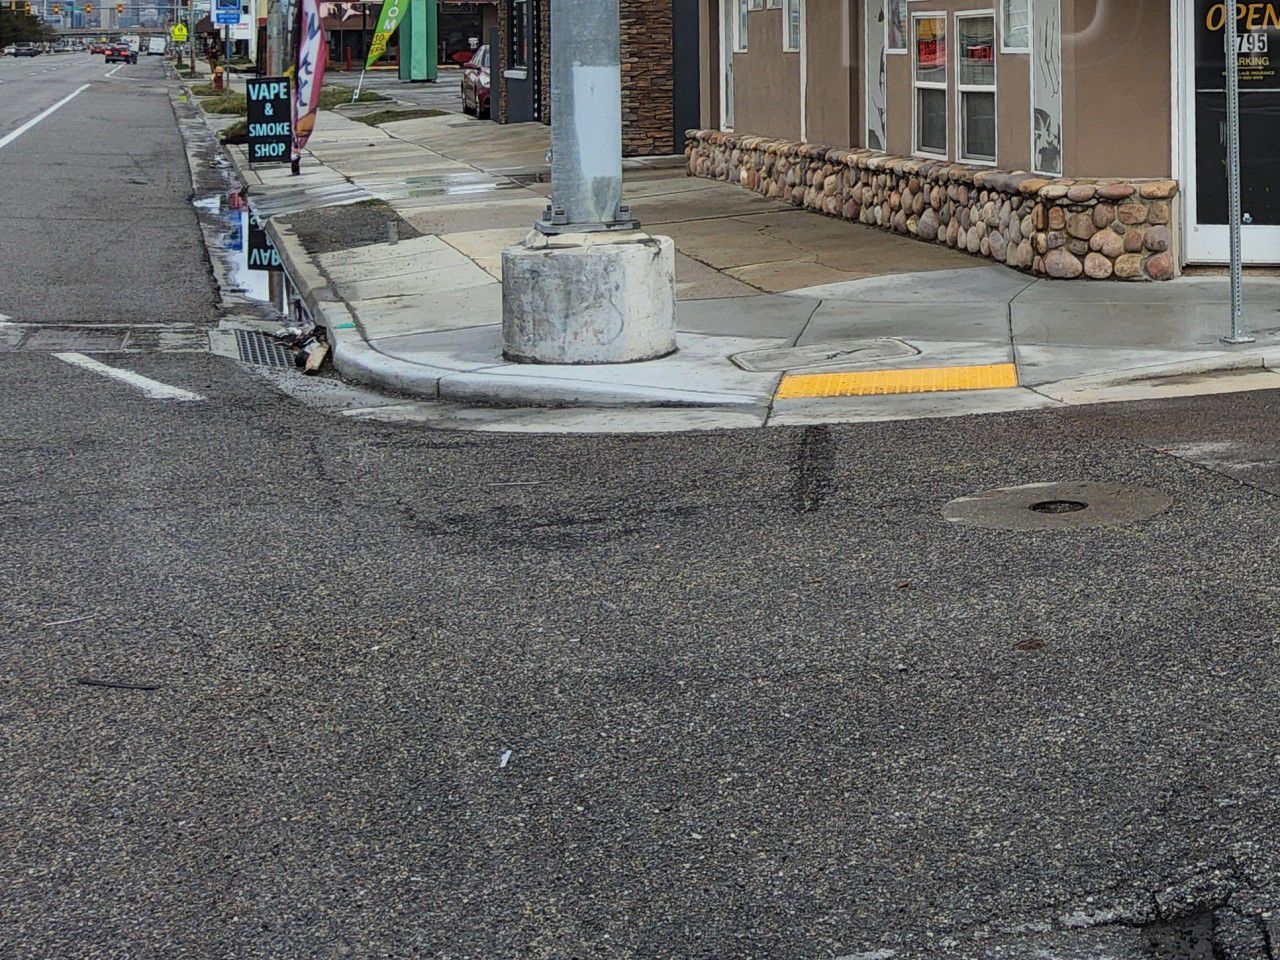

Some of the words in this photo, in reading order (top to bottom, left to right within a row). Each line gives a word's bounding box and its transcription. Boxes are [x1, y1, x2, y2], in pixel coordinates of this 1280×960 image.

[1237, 34, 1267, 52] 795
[1237, 56, 1270, 66] RKING
[249, 82, 288, 101] VAPE
[264, 102, 274, 116] &
[249, 122, 290, 137] SMOKE
[254, 142, 286, 158] SHOP
